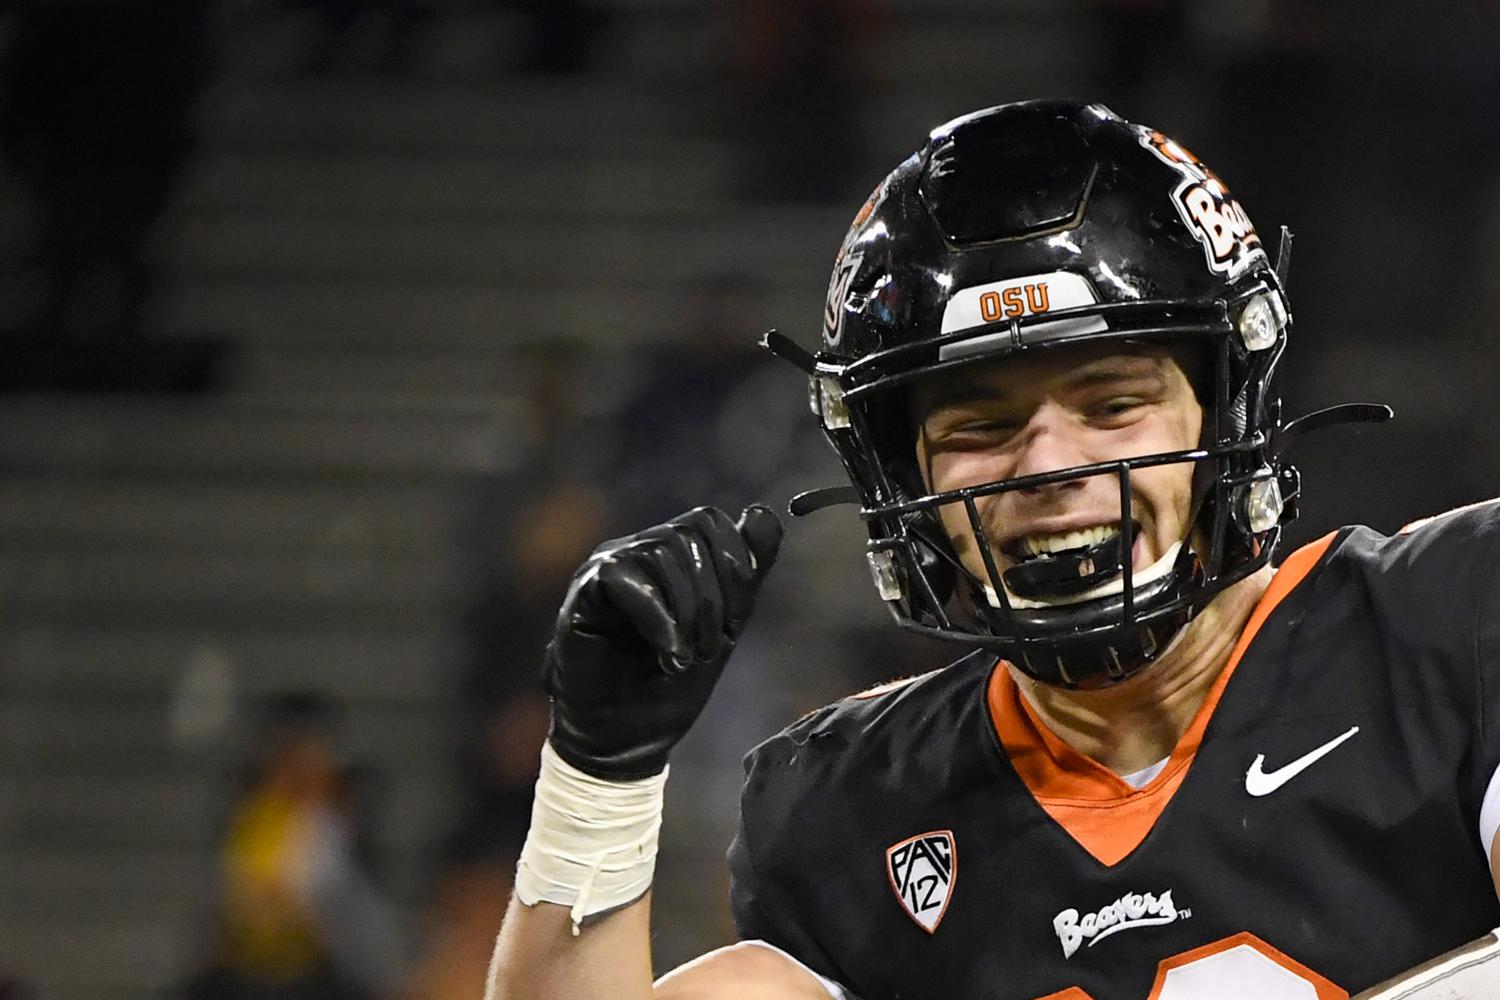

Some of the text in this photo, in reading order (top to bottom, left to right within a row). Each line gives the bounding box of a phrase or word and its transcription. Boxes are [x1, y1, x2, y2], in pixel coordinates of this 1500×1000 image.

[979, 282, 1051, 322] OSU
[890, 835, 951, 898] PAC
[909, 874, 942, 915] 12
[1052, 888, 1178, 960] Beavers
